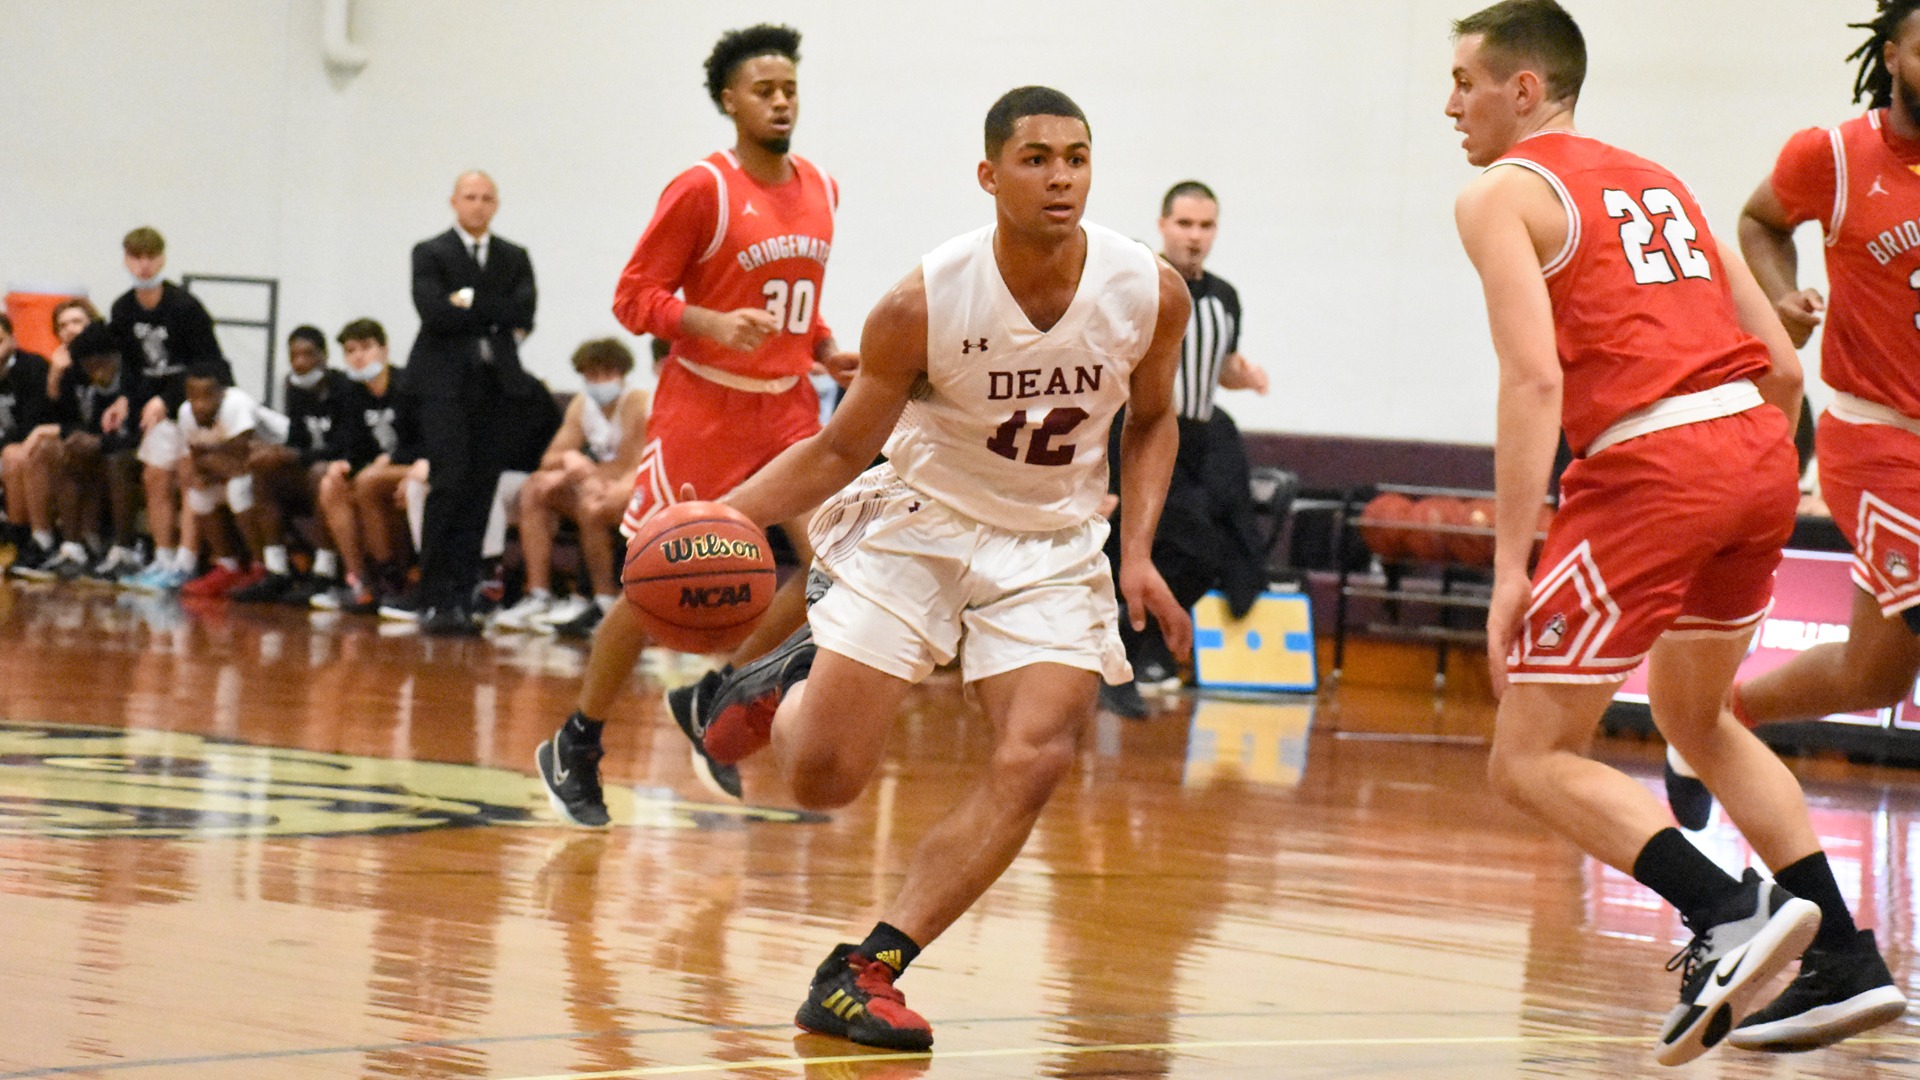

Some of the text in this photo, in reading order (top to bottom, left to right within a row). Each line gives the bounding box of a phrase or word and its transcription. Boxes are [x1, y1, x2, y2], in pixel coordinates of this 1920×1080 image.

[1602, 187, 1712, 285] 22
[1866, 217, 1920, 266] BRID
[762, 279, 815, 334] 30
[987, 364, 1103, 400] DEAN
[986, 407, 1090, 466] 12
[660, 533, 763, 563] Wilson
[679, 582, 752, 609] NCAA
